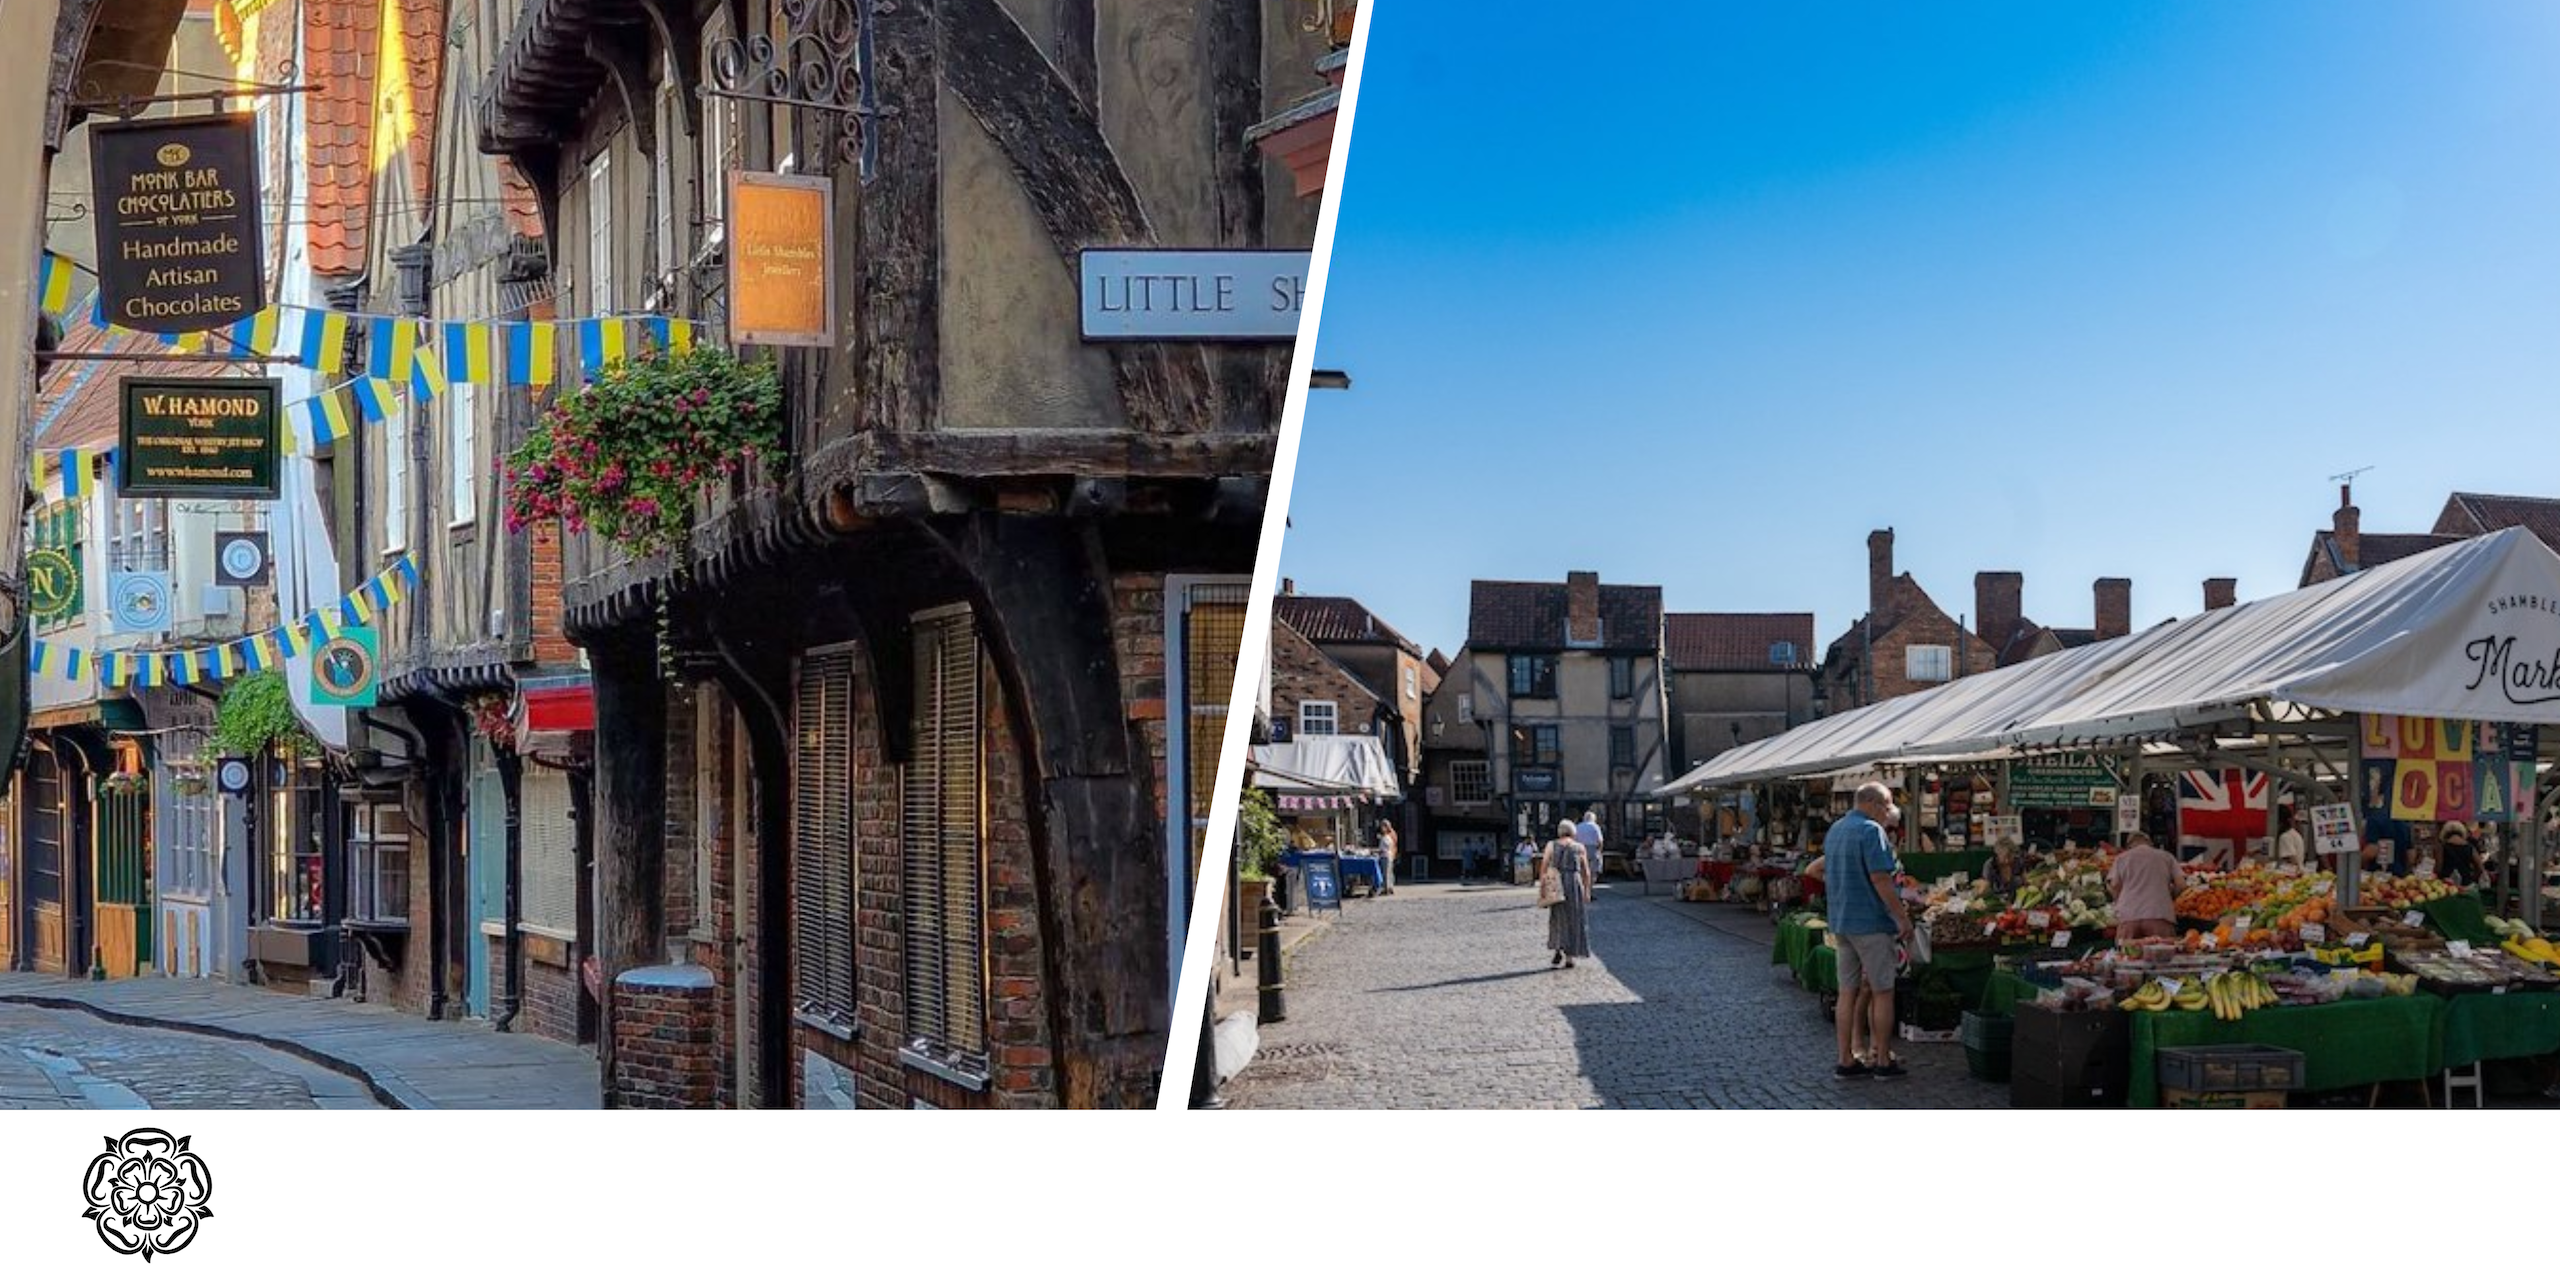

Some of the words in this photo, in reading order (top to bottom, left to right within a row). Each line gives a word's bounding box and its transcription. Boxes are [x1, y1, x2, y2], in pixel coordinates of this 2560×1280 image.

[131, 172, 178, 191] MONK
[185, 168, 218, 188] BAR
[118, 189, 236, 215] CHOCOLATIERS
[122, 231, 240, 260] Handmade
[145, 265, 219, 288] Artisan
[125, 291, 242, 318] Chocolates
[1098, 274, 1236, 313] LITTLE
[2488, 595, 2560, 614] SHAMBLE
[2366, 712, 2501, 753] LOVE
